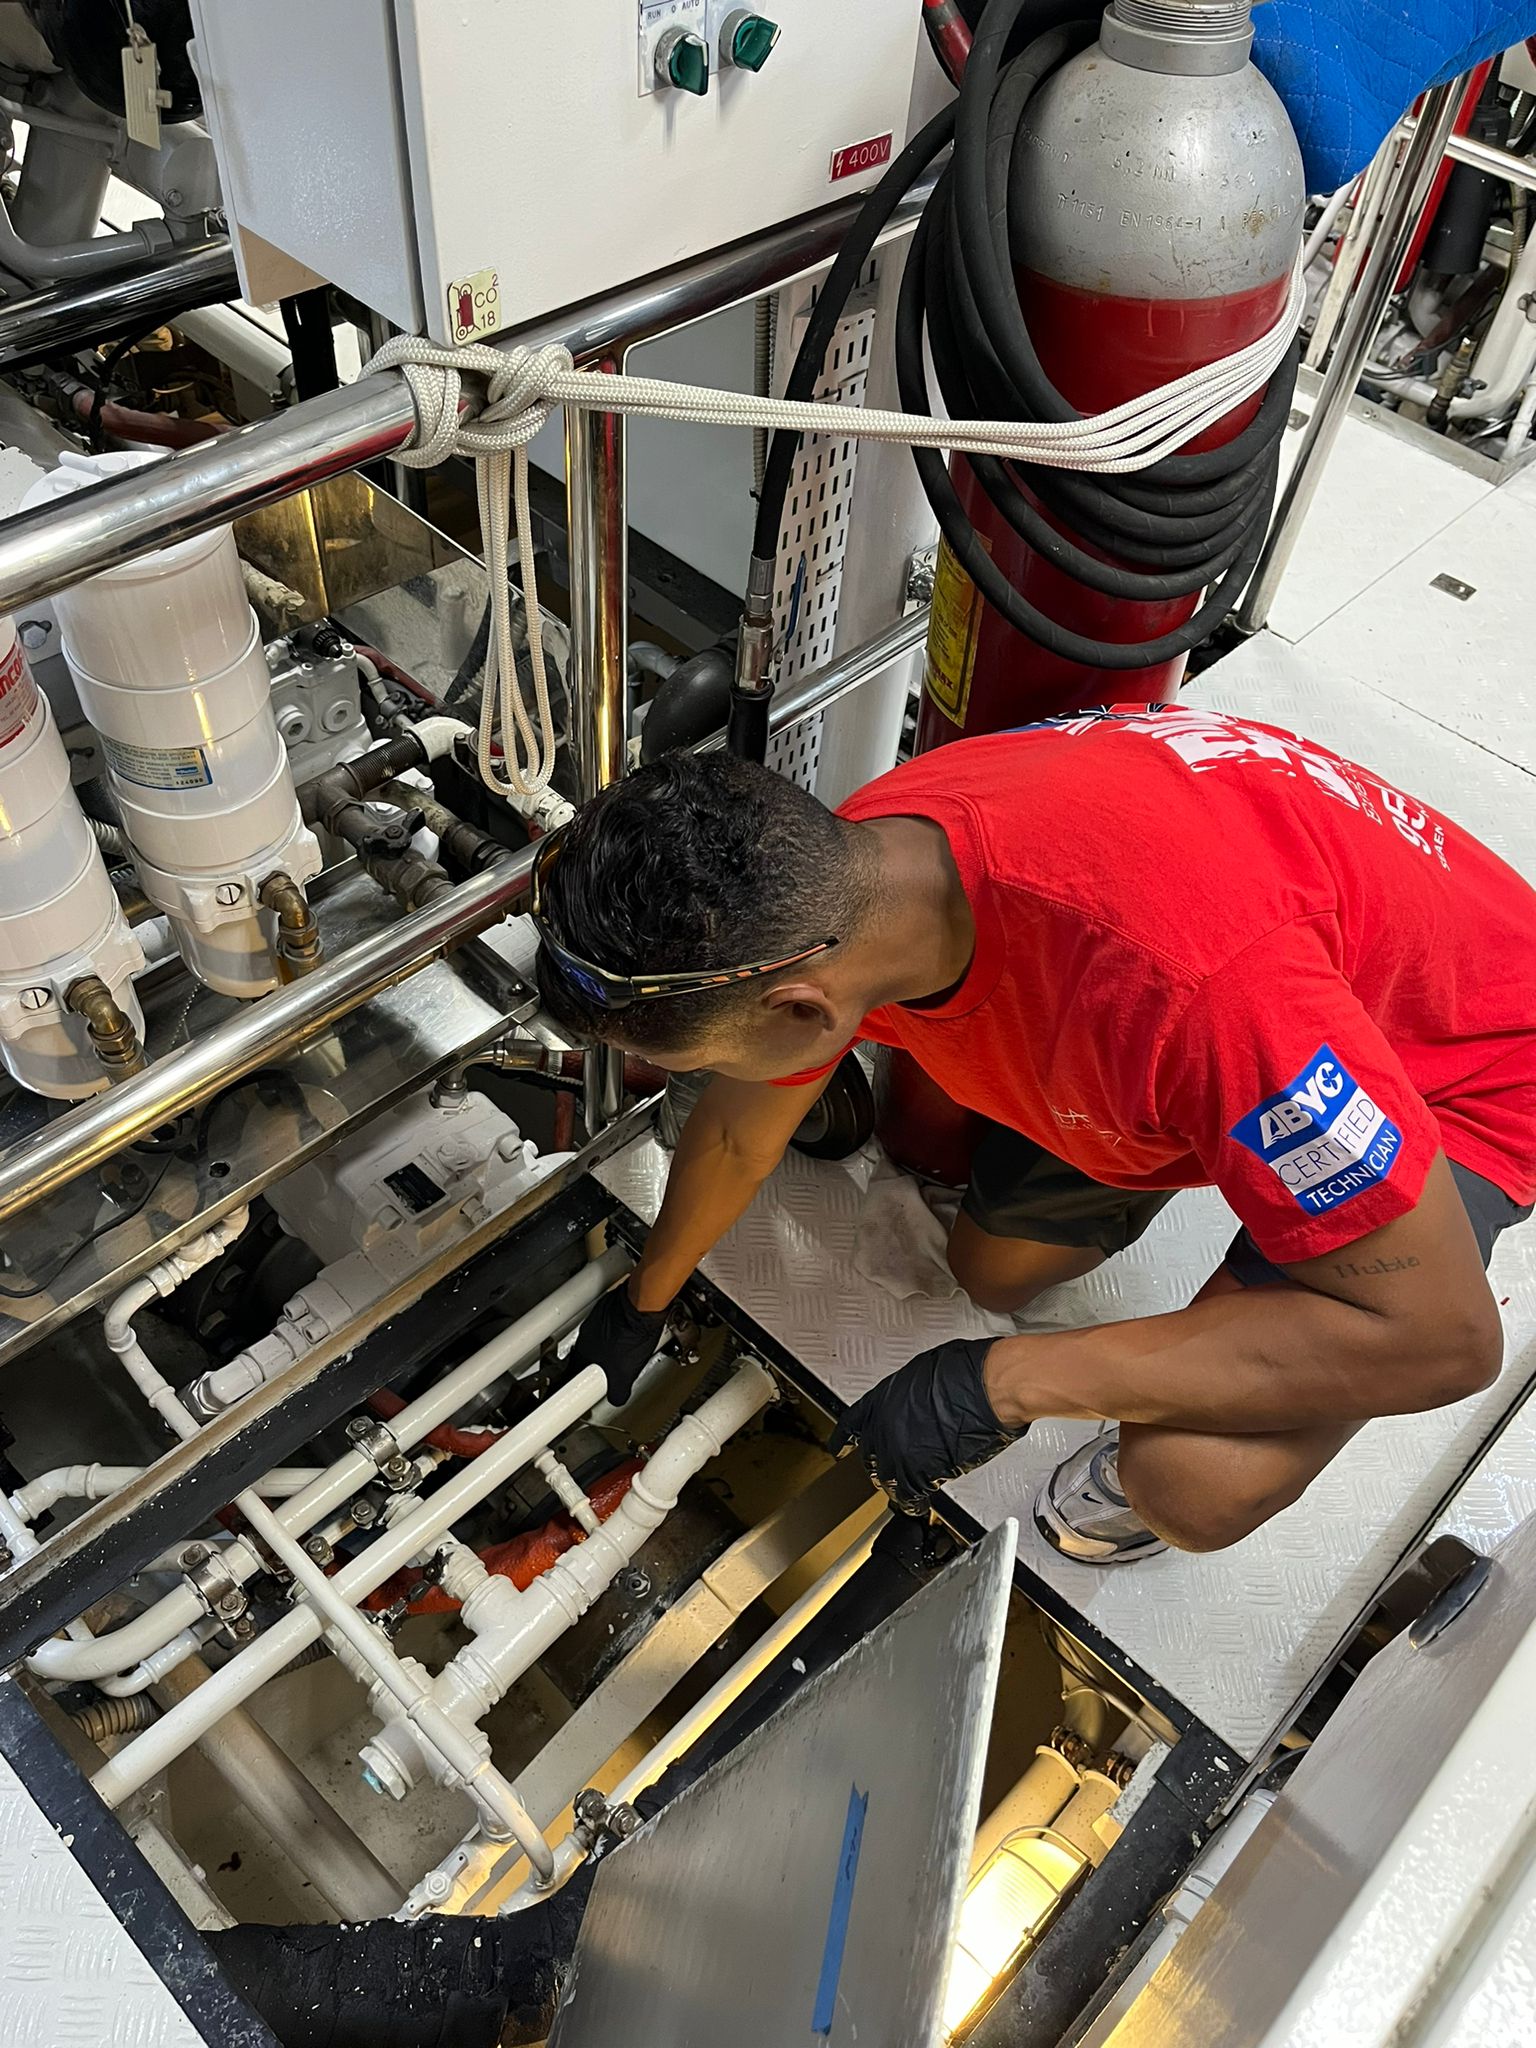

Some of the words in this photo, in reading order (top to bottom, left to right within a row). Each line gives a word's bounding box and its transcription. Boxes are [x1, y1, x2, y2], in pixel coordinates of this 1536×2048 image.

[647, 9, 661, 20] RUN
[681, 0, 700, 11] AUTO
[848, 139, 889, 168] 400V
[480, 310, 496, 329] 18
[1258, 1061, 1344, 1150] ABYC
[1278, 1098, 1376, 1186] CERTIFIED
[1306, 1129, 1399, 1209] TECHNICIAN
